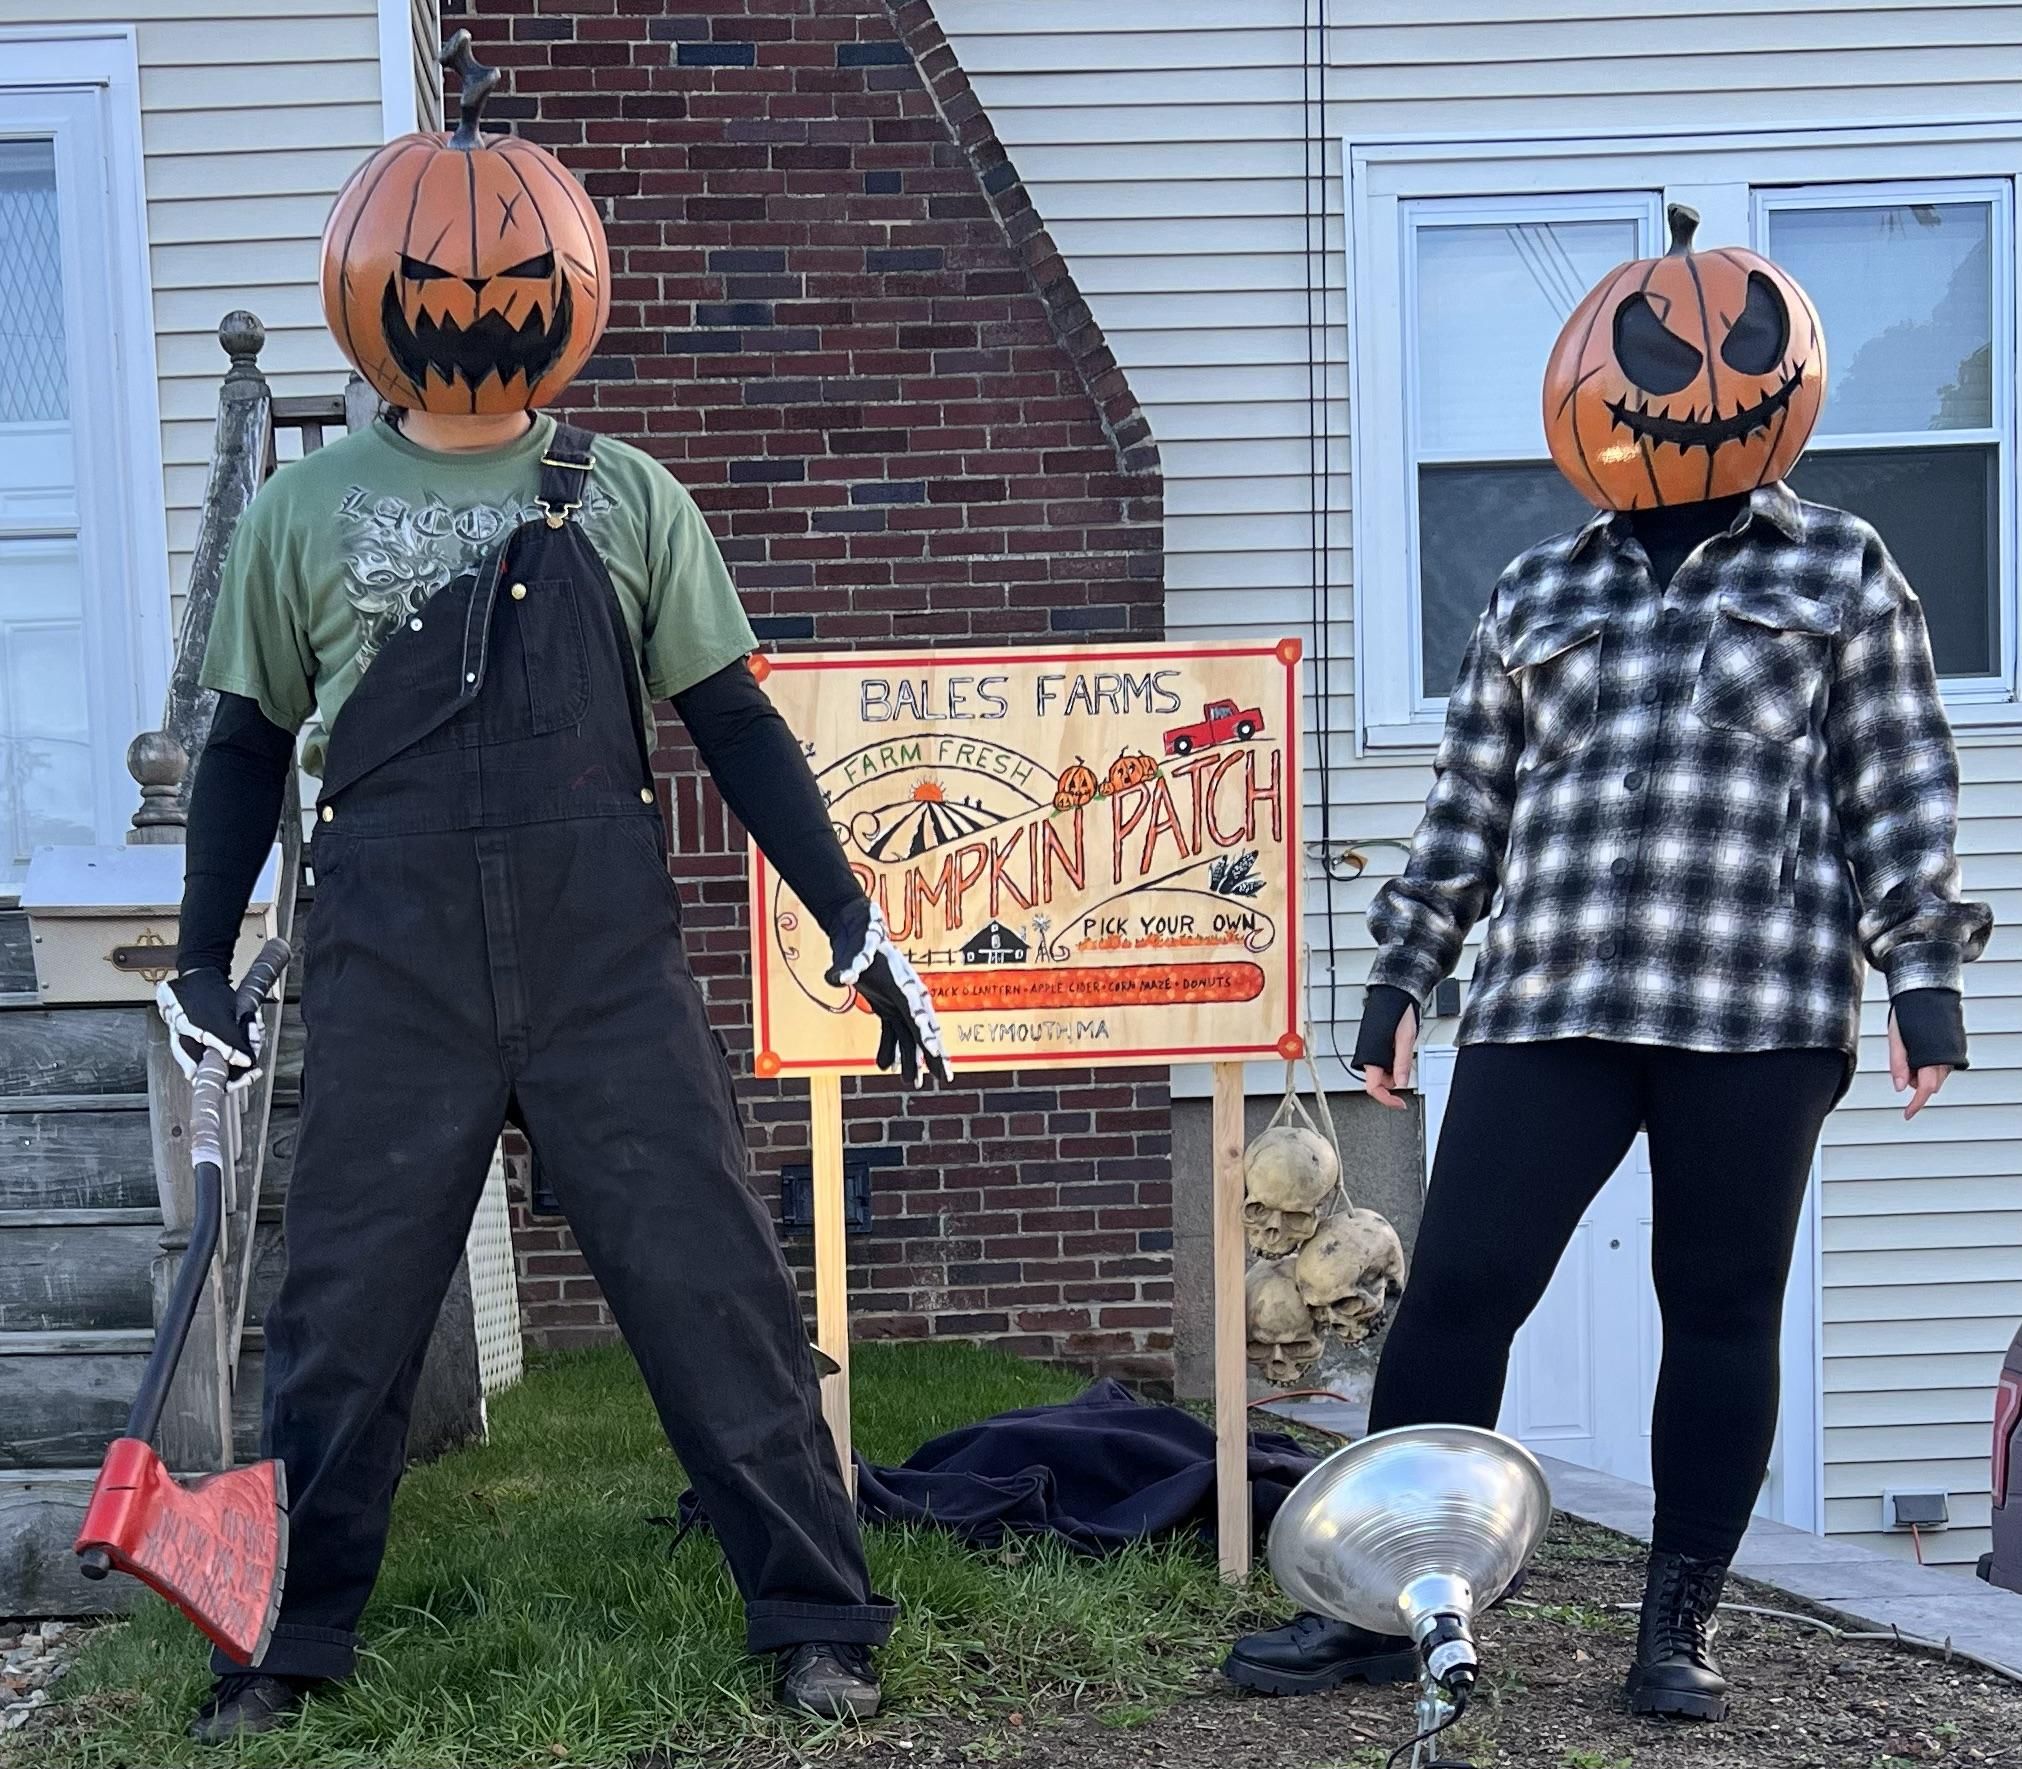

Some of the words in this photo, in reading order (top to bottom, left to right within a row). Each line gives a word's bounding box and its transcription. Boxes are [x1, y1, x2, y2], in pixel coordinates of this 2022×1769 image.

[861, 676, 1009, 721] BALES
[1037, 670, 1182, 717] FARMS
[843, 742, 922, 785] FARM
[939, 739, 1035, 787] FRESH
[1112, 749, 1282, 884] PATCH
[1084, 917, 1129, 936] PICK
[1140, 915, 1195, 935] YOUR
[1213, 913, 1256, 932] OWN
[930, 986, 958, 998] JACK
[1030, 982, 1062, 994] APPLE
[1069, 981, 1100, 993] CIDER
[1108, 980, 1136, 992] CORN
[1140, 978, 1171, 992] MAZE
[1183, 977, 1231, 989] DONUTS
[1076, 1020, 1110, 1040] MA
